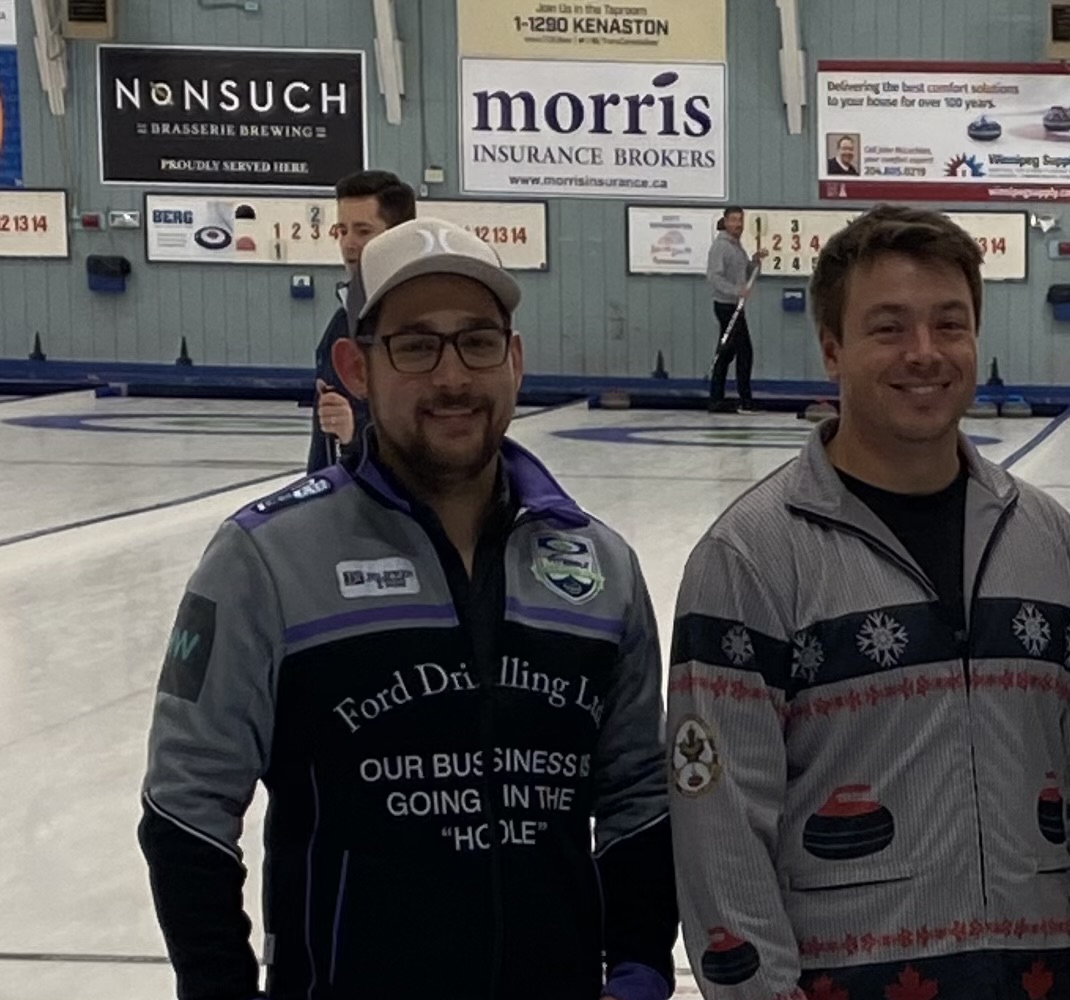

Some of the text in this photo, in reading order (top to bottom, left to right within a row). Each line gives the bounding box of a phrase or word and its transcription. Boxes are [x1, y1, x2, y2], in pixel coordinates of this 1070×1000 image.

[514, 16, 669, 36] 1-1290 KENASTON
[115, 78, 347, 115] NONSUCH
[827, 81, 880, 95] Delivering
[882, 81, 899, 92] the
[902, 81, 925, 93] best
[471, 71, 712, 138] morris
[901, 96, 915, 107] for
[918, 98, 941, 108] over
[151, 123, 313, 138] BRASSERIE BREWING
[472, 145, 716, 168] INSURANCE BROKERS
[160, 158, 309, 174] PROUDLY SERVED HERE
[509, 175, 668, 189] www.morrisinsurance.ca
[14, 216, 29, 231] 13
[32, 216, 47, 232] 14
[152, 209, 193, 225] BERG
[310, 207, 320, 223] 2
[273, 222, 280, 239] 1
[291, 223, 301, 240] 2
[310, 223, 320, 240] 3
[474, 225, 527, 245] 12 13 14
[791, 219, 799, 233] 3
[772, 234, 782, 251] 2
[791, 234, 801, 252] 3
[810, 235, 820, 252] 4
[991, 237, 1006, 255] 14
[773, 256, 782, 270] 2
[792, 256, 800, 271] 4
[332, 670, 413, 734] Ford
[359, 754, 425, 782] OUR
[385, 783, 576, 817] GOING IN THE
